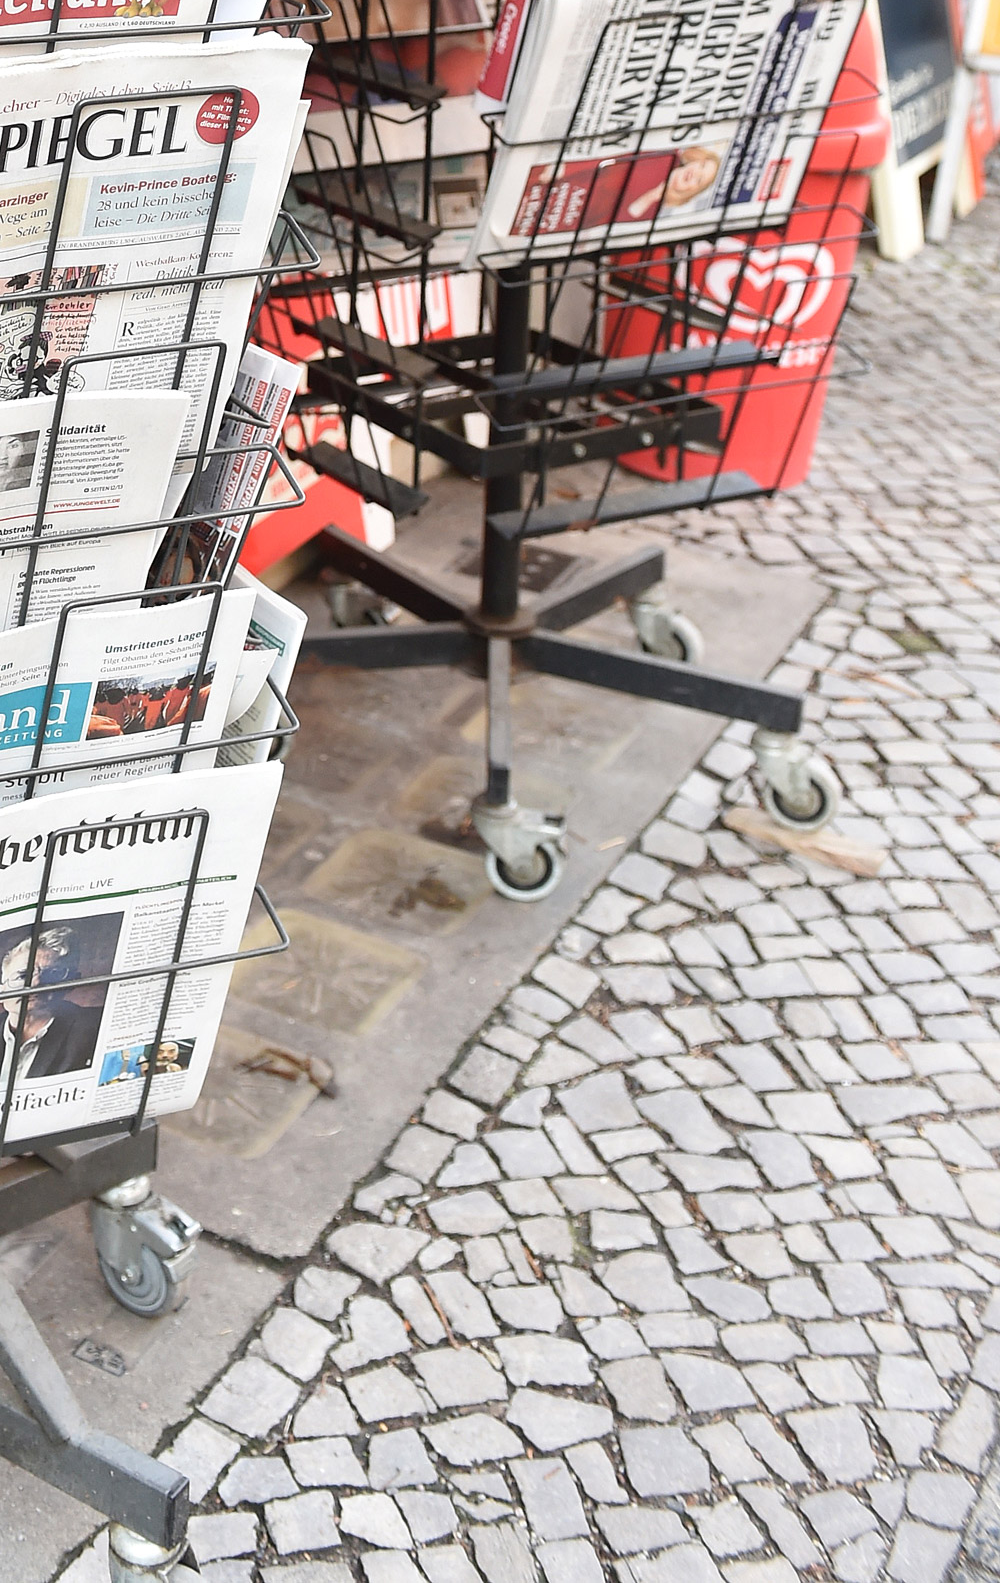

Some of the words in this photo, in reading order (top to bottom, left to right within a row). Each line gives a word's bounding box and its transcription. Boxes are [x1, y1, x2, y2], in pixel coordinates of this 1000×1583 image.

[646, 67, 687, 109] ON
[713, 33, 764, 122] MORE
[99, 179, 180, 196] Kevin-Prince
[181, 172, 238, 189] Boateg:
[28, 207, 49, 219] am
[104, 635, 175, 655] Umstrittenes
[89, 877, 114, 890] LIVE
